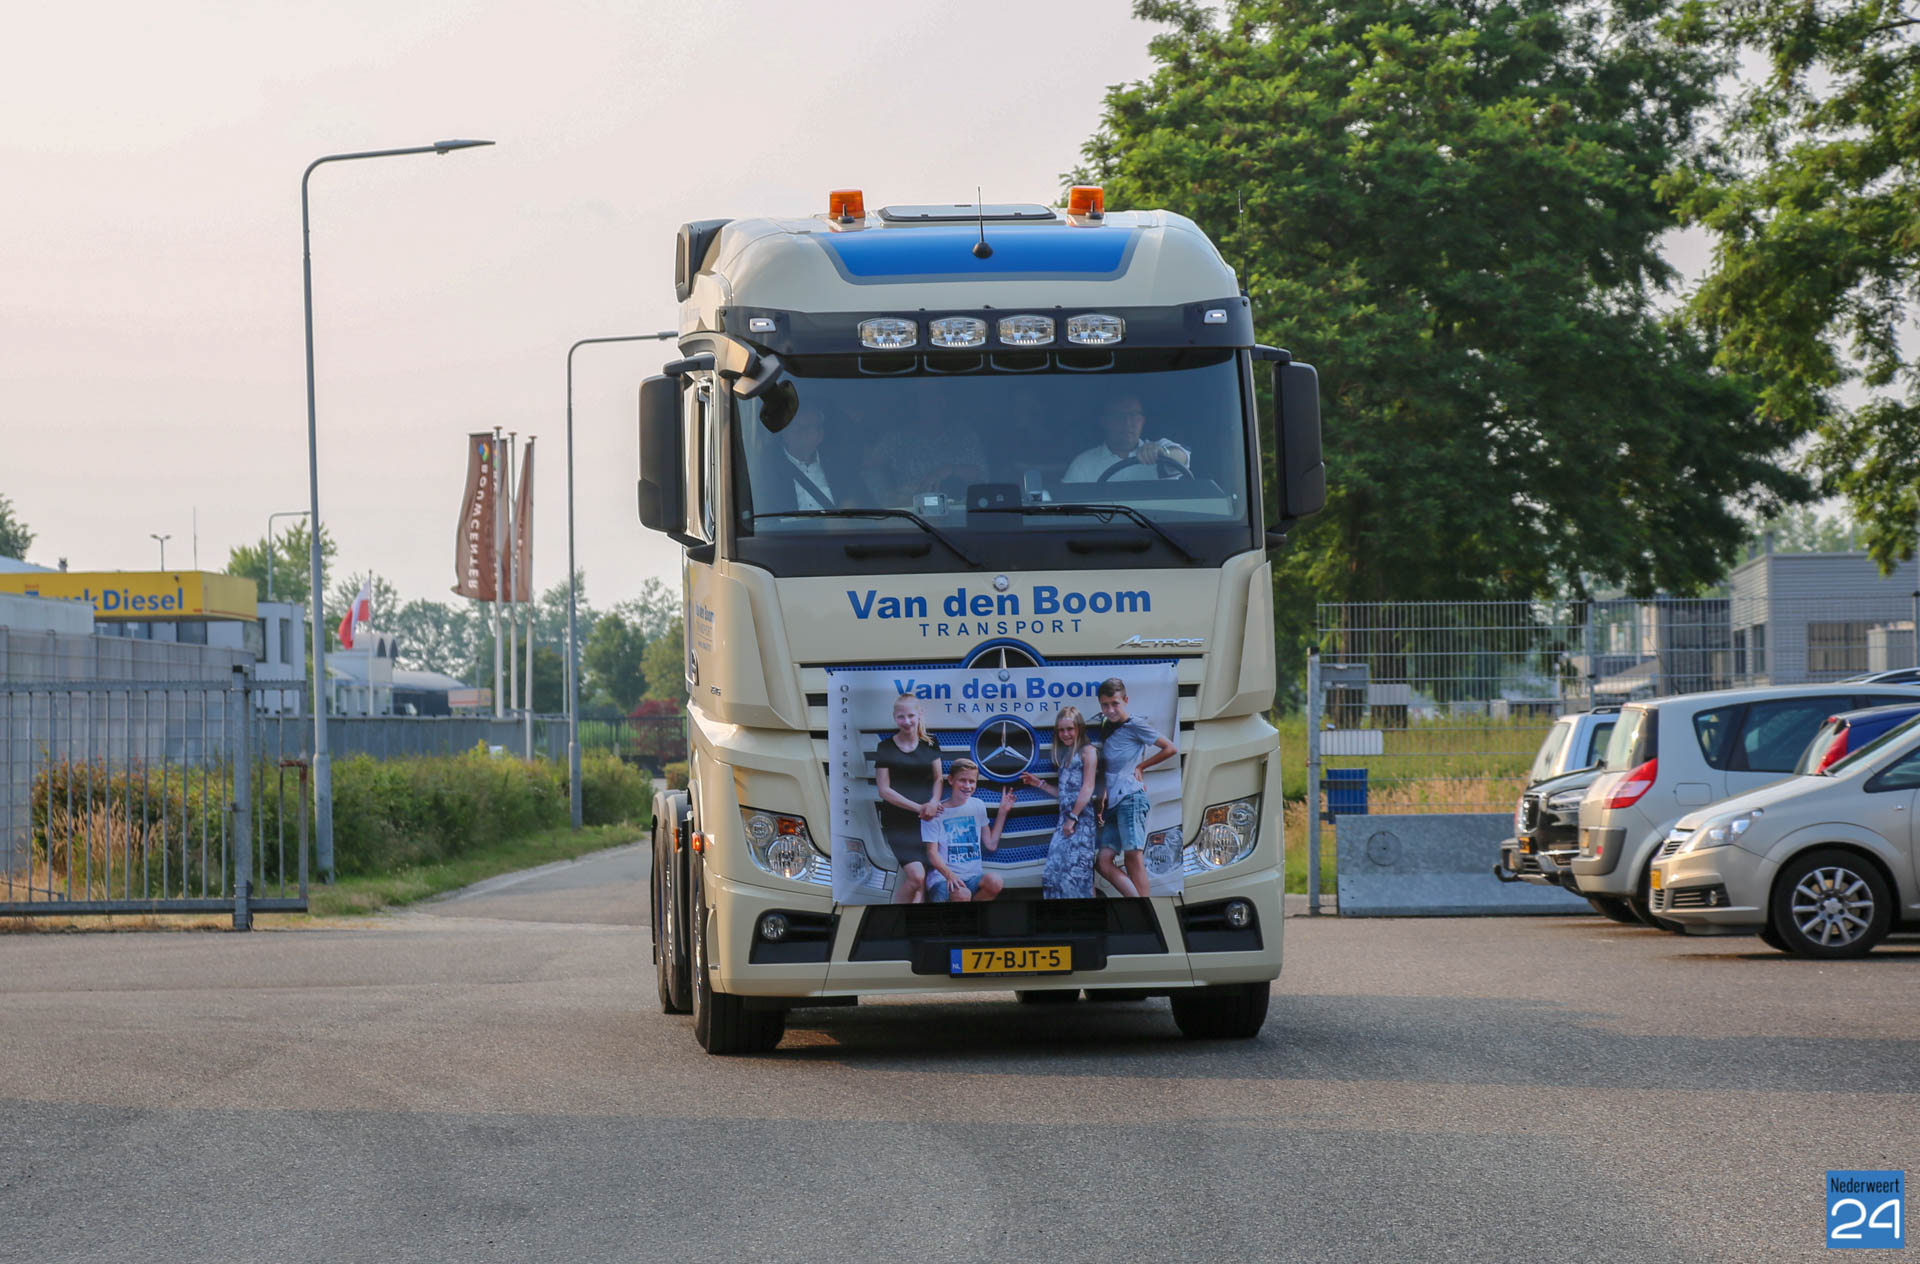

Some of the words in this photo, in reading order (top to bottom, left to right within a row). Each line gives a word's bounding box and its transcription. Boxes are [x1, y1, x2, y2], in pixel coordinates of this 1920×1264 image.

[847, 589, 928, 620] Van
[943, 587, 1018, 617] den
[1033, 585, 1152, 615] Boom
[919, 619, 1082, 638] TRANSPORT
[893, 679, 952, 700] Van
[962, 677, 1017, 700] den
[944, 701, 1062, 713] TRANSPORT
[971, 950, 1061, 970] 77-BJT-5
